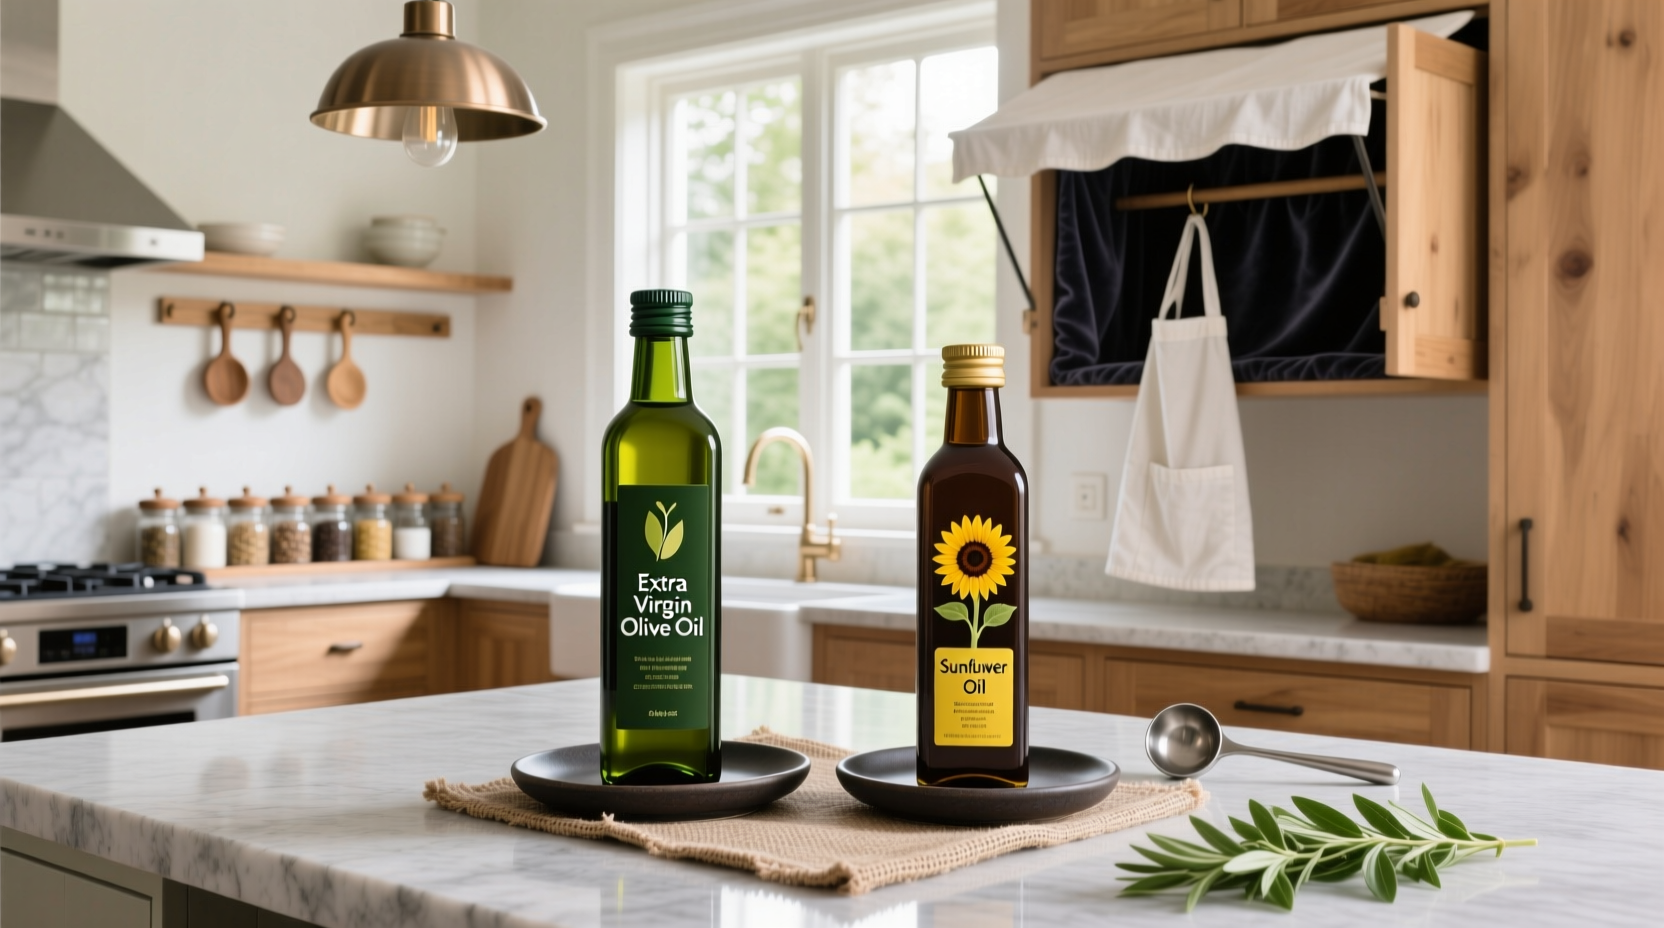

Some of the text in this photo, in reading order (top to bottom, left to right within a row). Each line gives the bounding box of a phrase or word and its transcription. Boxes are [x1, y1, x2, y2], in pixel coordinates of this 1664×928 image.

[638, 573, 687, 592] Extra
[633, 595, 692, 619] Virgin
[620, 616, 703, 637] Olive Oil
[963, 679, 986, 694] Oil
